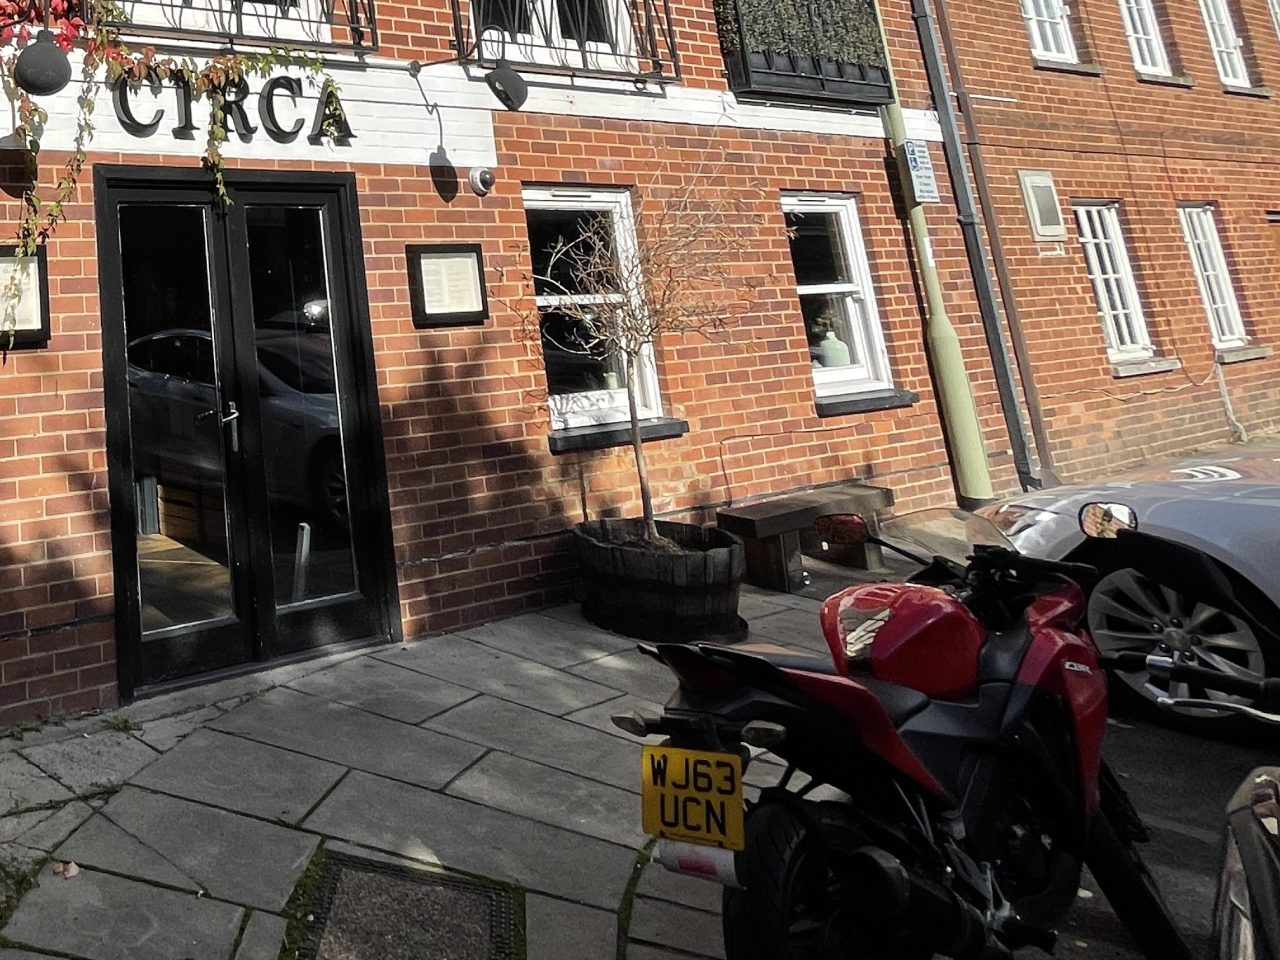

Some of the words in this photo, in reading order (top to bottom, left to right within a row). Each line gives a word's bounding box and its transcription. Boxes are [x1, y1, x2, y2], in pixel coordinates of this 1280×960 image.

[112, 66, 358, 148] CIRCA
[650, 753, 736, 796] WJ63
[660, 793, 727, 837] UCN
